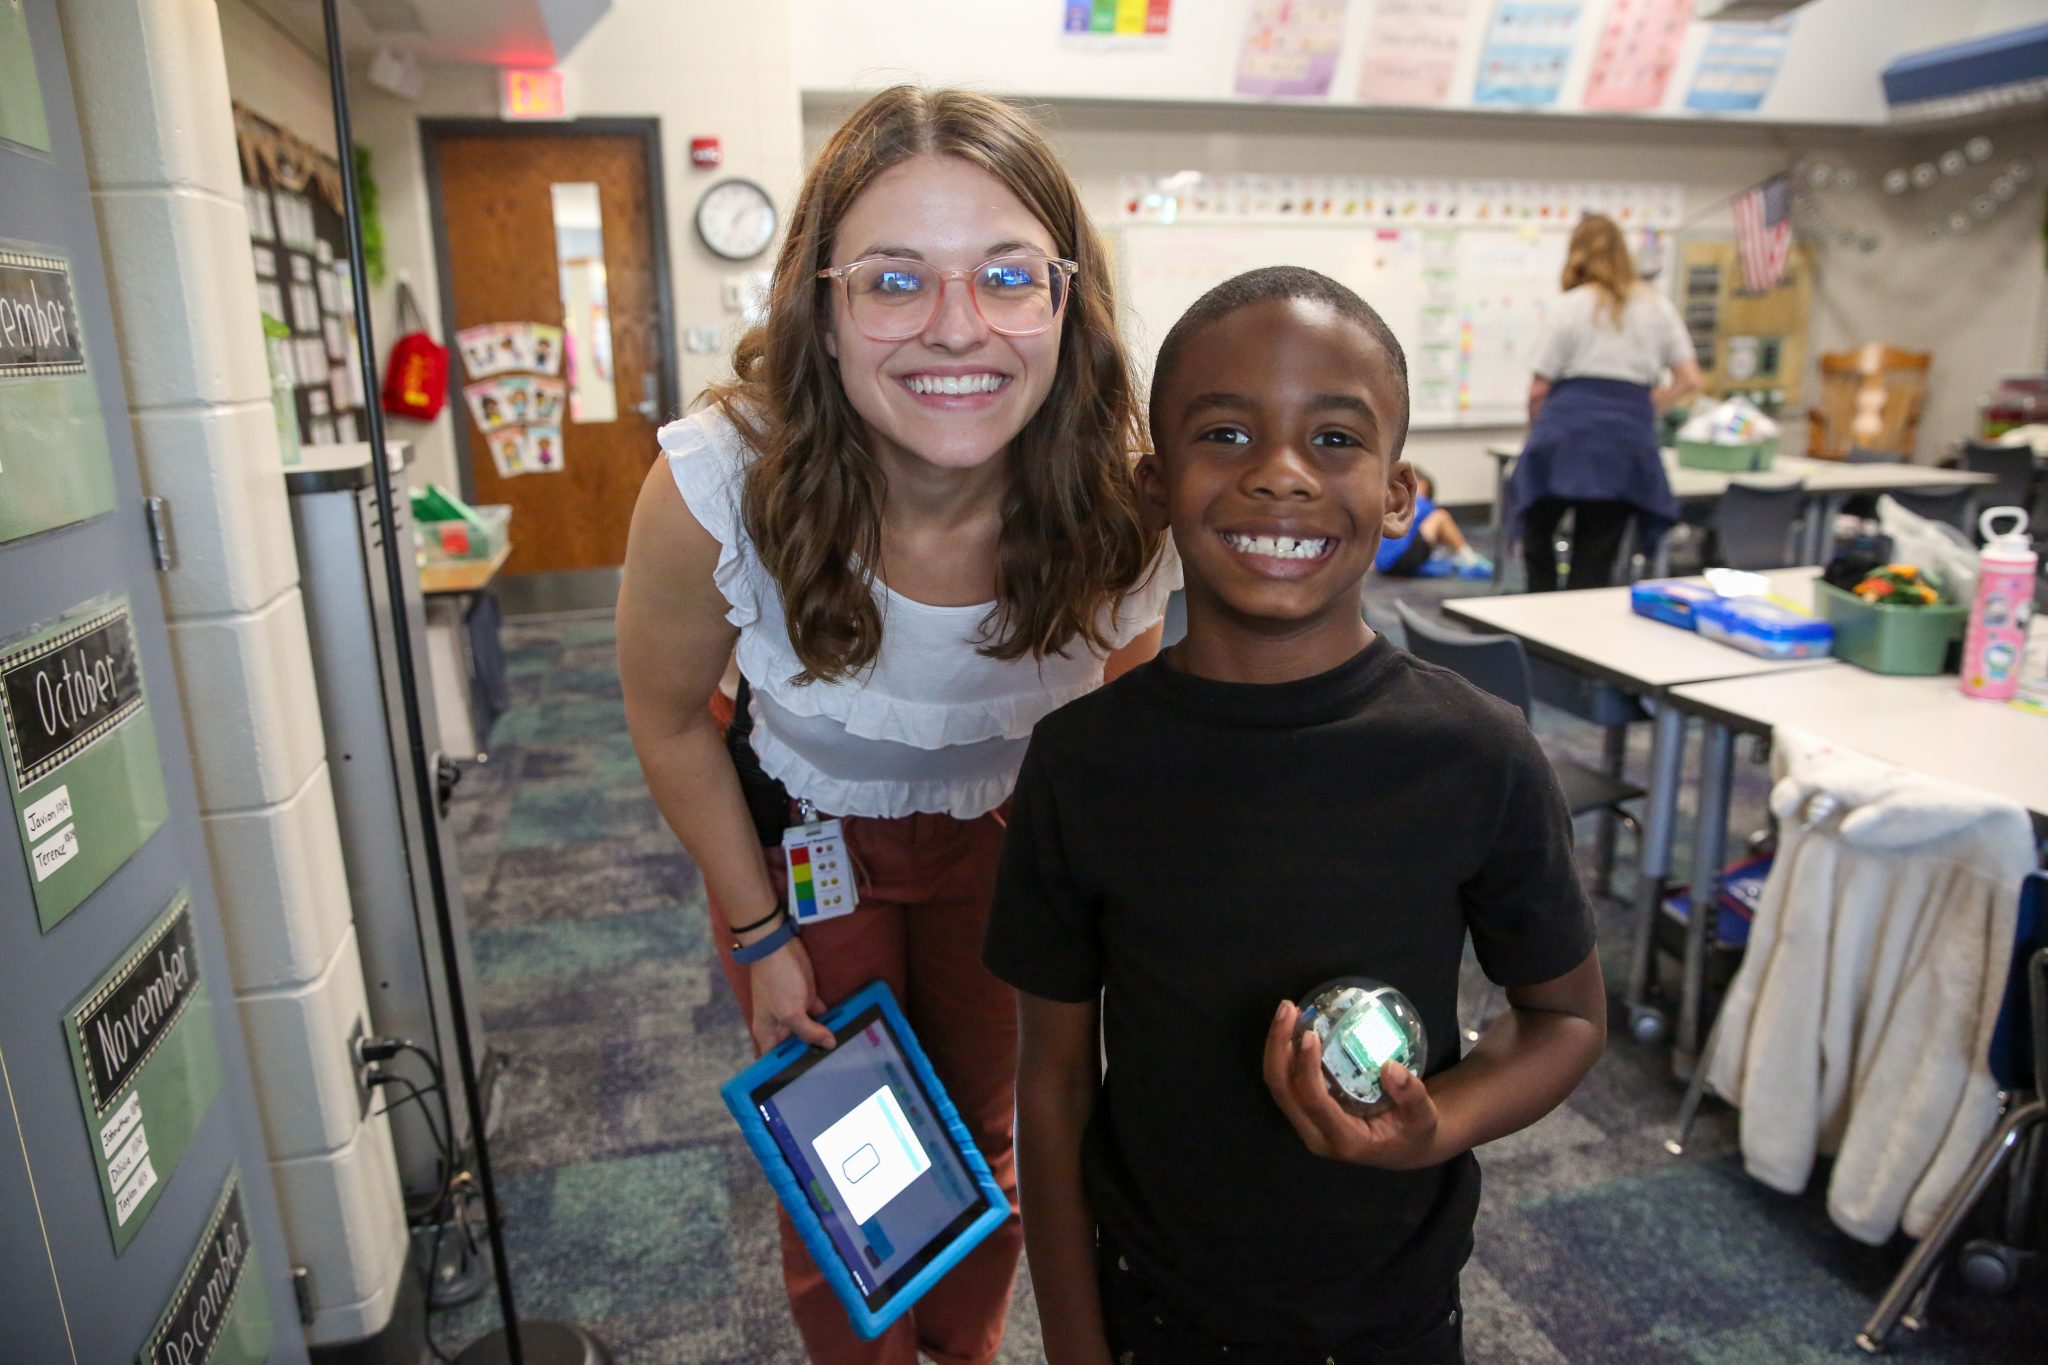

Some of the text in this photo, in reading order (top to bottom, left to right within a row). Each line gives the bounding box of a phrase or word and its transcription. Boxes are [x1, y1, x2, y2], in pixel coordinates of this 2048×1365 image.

[0, 279, 69, 349] ember
[36, 649, 117, 736] October
[28, 811, 57, 832] Javion
[36, 844, 67, 867] Terence
[97, 945, 189, 1081] November
